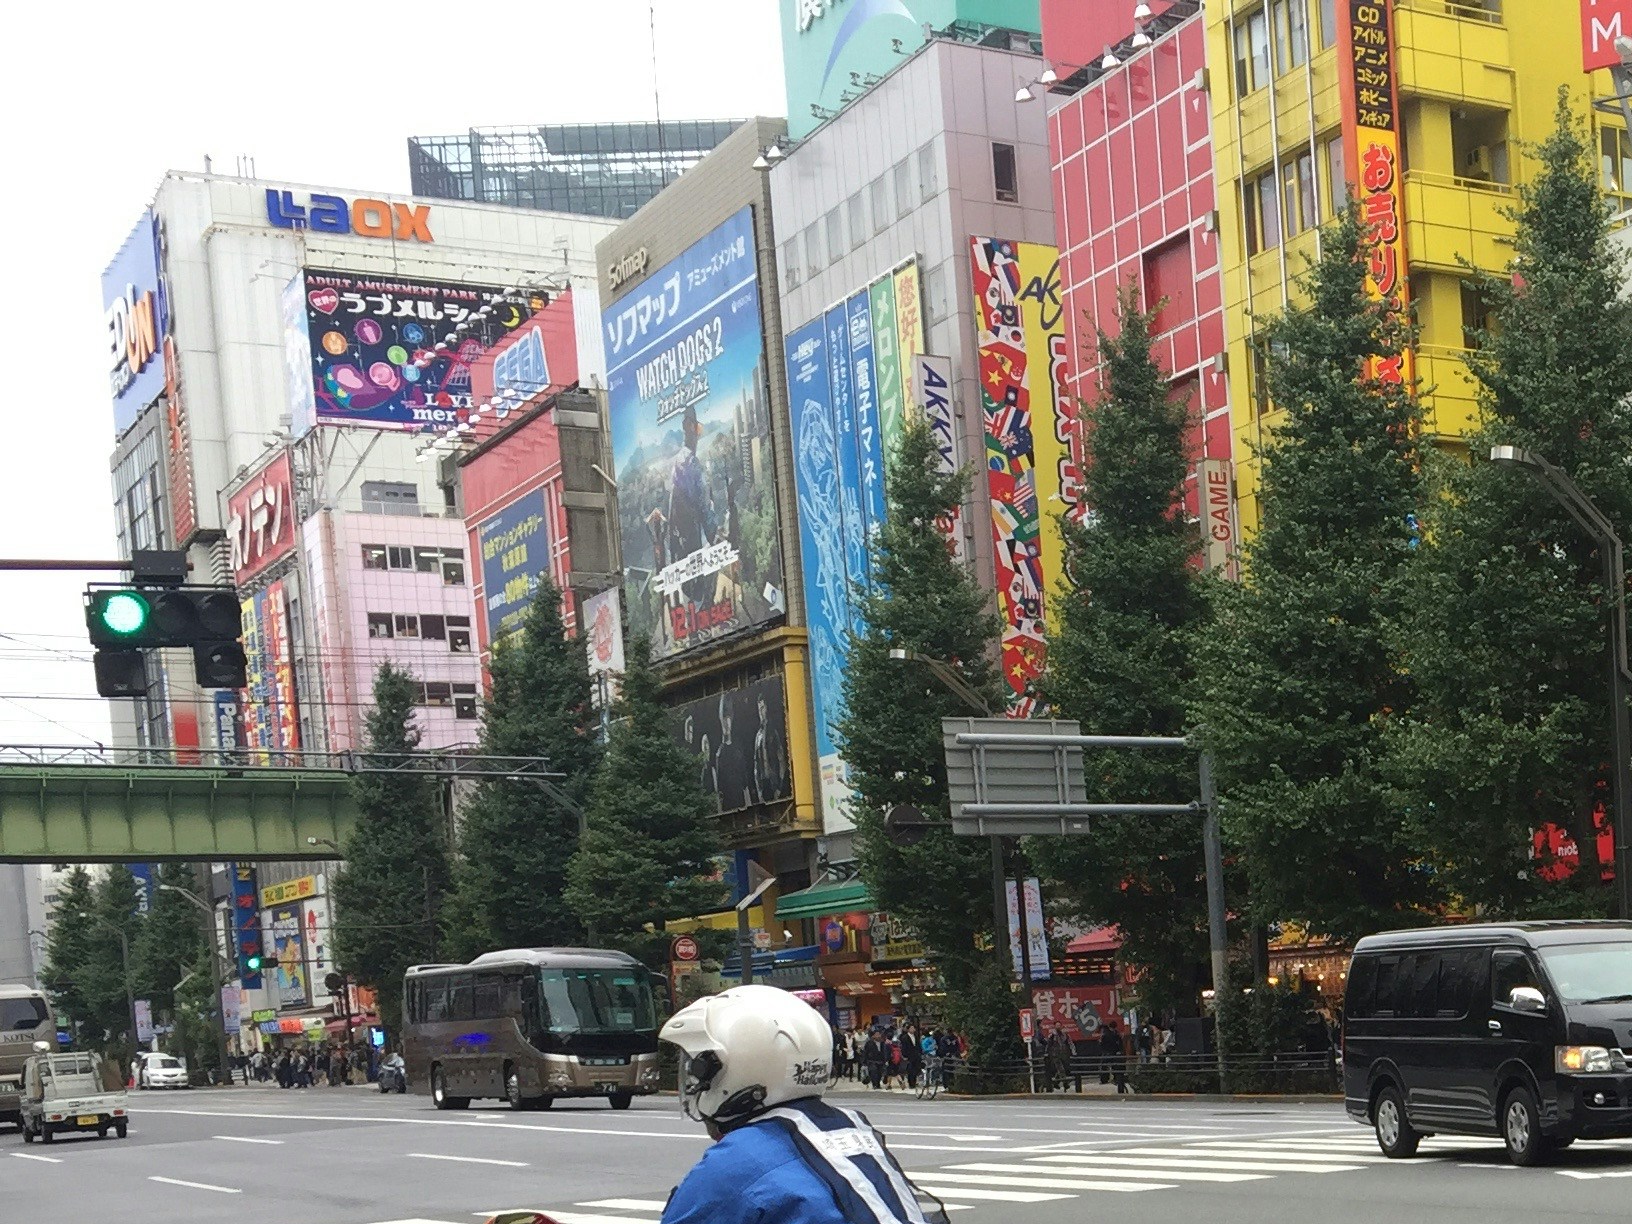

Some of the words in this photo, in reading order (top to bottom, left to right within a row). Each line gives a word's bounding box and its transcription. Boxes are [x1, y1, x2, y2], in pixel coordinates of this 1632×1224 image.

[1357, 6, 1380, 24] CD
[1353, 25, 1386, 45] アイドル
[1354, 46, 1388, 65] アニメ
[1357, 68, 1388, 87] コミック
[1359, 88, 1388, 106] ホビー
[1359, 109, 1390, 127] フィギュア
[608, 247, 648, 291] Sofmap
[306, 275, 351, 290] ADULT
[357, 281, 440, 299] AMUSEMENT
[442, 288, 478, 300] PARK
[607, 270, 681, 354] ソフマップ
[636, 346, 679, 402] WATCH
[677, 322, 713, 374] DOGS
[713, 316, 724, 358] 2
[1207, 470, 1231, 541] GAME
